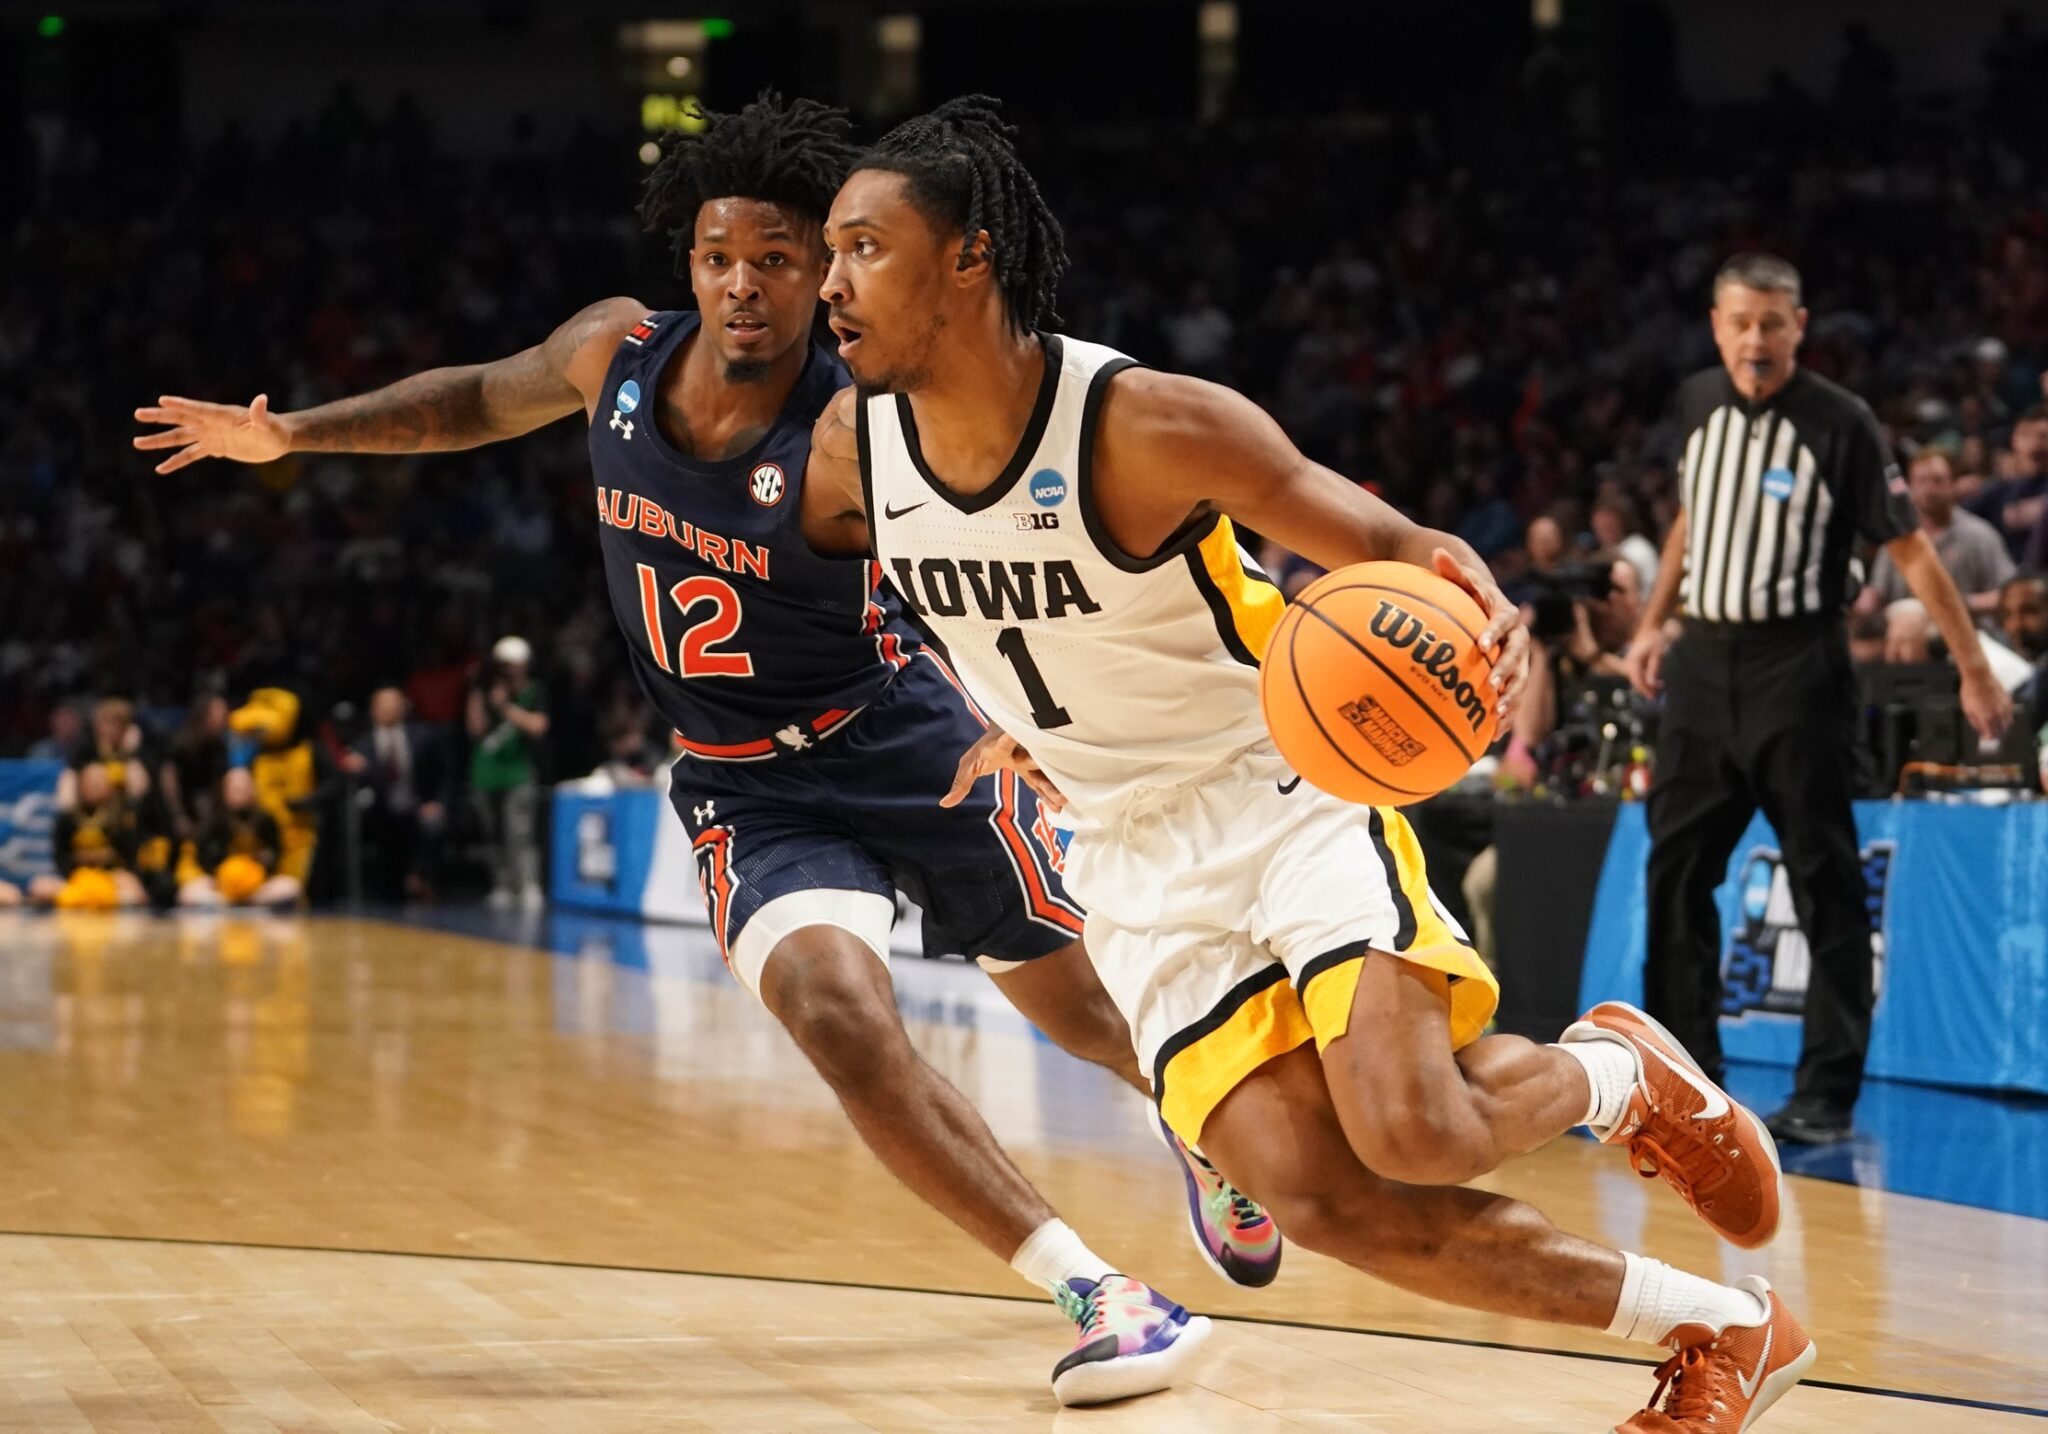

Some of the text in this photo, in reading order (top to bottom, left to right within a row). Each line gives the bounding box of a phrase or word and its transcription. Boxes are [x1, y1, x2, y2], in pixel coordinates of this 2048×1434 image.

[751, 465, 782, 504] SEC
[1035, 485, 1065, 499] NCAA
[597, 486, 770, 581] AUBURN
[636, 562, 756, 679] 12
[890, 557, 1103, 621] IOWA
[995, 626, 1074, 730] 1
[1368, 599, 1487, 733] Wilson
